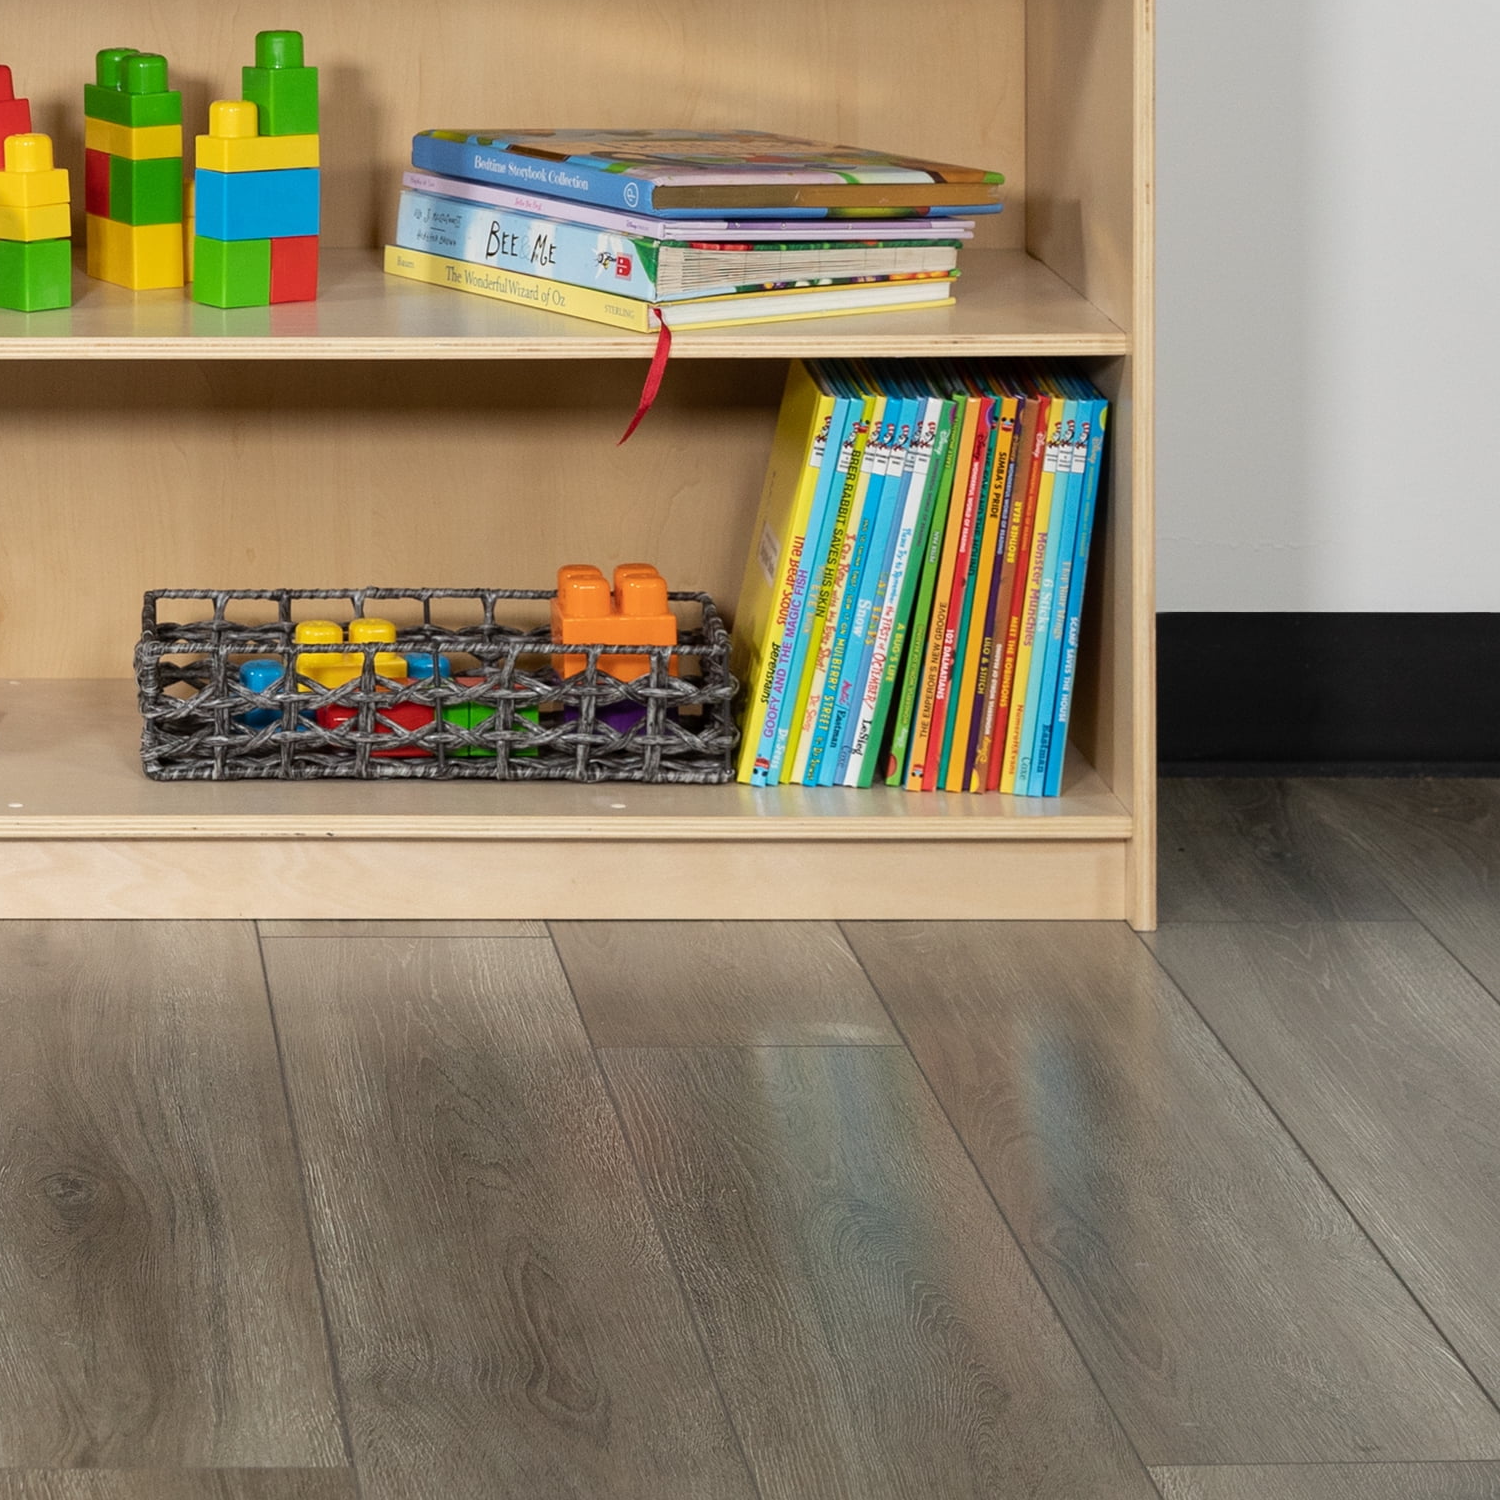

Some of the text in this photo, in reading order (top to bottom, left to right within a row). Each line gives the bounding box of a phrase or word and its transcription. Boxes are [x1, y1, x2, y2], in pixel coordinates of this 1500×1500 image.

[474, 154, 589, 192] Bedtime Storybook Collection
[445, 265, 566, 307] The Wonderful Wizard of Oz
[604, 304, 635, 320] STERLING
[958, 461, 980, 553] WONDERFUL WORLD READING
[989, 451, 1007, 519] SIMBA'S PRIDE
[815, 449, 862, 618] BRER RABBIT SAVES HIS SKIN
[1006, 501, 1023, 564] BROTHER BEAR
[851, 598, 872, 638] Snow
[1022, 531, 1049, 647] Monster Munchies
[1036, 591, 1053, 633] Sticks
[762, 569, 809, 739] GOOFY AND THE MAGIC FISH
[818, 637, 847, 731] MULBERRY STREET
[885, 632, 904, 683] BUG'S LIFE
[919, 601, 948, 739] THE EMPEROR'S NEW GROOVE
[935, 628, 955, 701] 102 DALMATIANS
[976, 636, 993, 695] LILO STITCH
[999, 615, 1019, 709] MEET THE ROBINSONS
[1057, 648, 1075, 724] SAVES THE HOUSE
[852, 718, 873, 756] LeSieg
